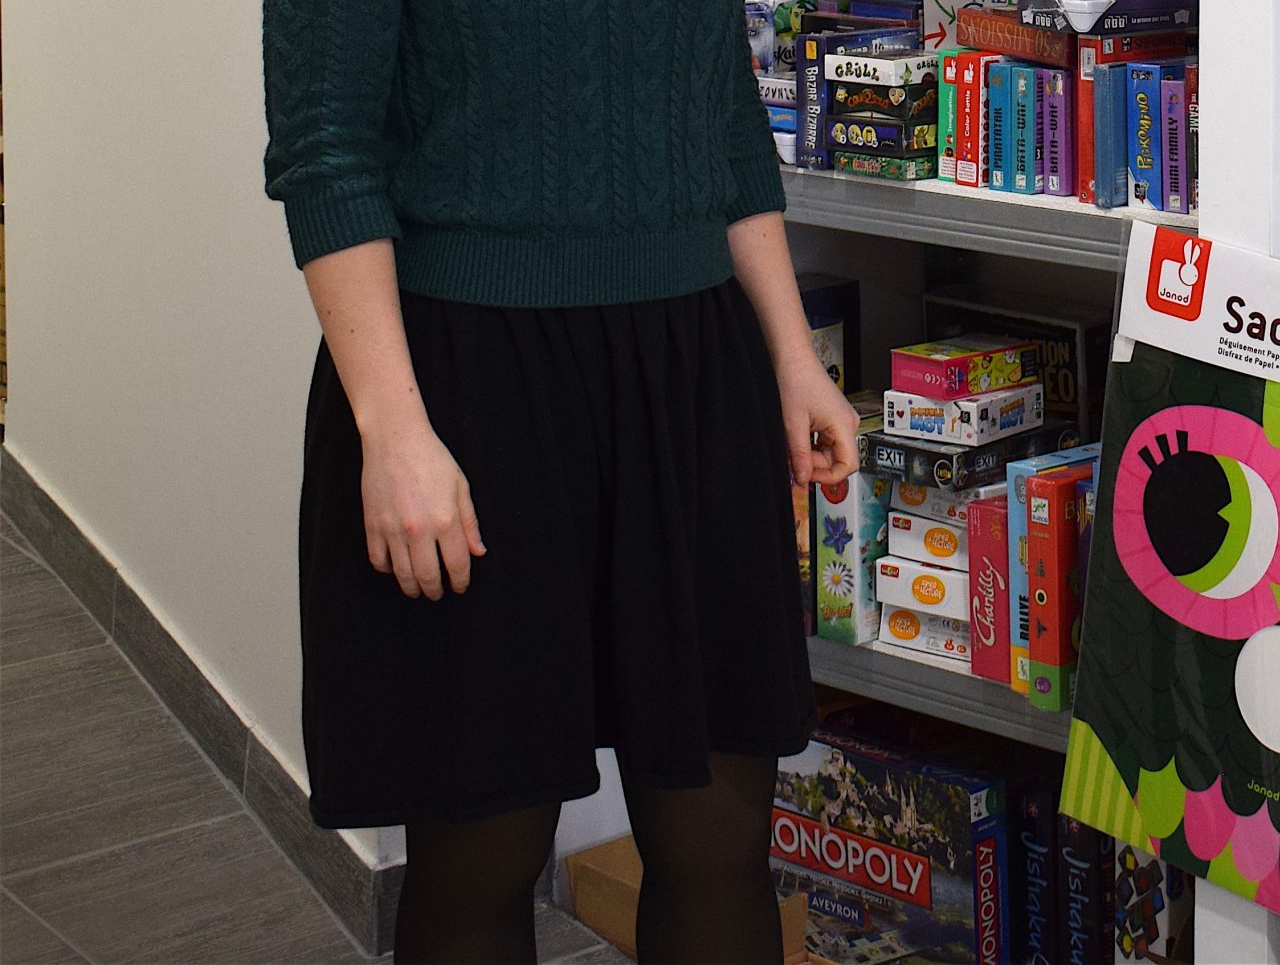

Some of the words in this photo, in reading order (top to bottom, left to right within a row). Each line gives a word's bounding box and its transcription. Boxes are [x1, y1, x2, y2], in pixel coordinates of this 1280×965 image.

[805, 66, 819, 102] BAZAR
[806, 105, 821, 150] BIZARRE
[1188, 104, 1199, 134] GAME
[993, 107, 1002, 168] PIRATATAK
[1049, 101, 1058, 174] BATA-WAF
[1167, 117, 1178, 159] FAMILY
[1168, 161, 1180, 193] MINI
[1159, 287, 1191, 306] Janod
[1217, 347, 1243, 361] Disfraz
[1244, 354, 1254, 363] de
[1254, 356, 1275, 370] Papel
[1219, 336, 1266, 358] Déguisement
[910, 415, 945, 435] MOT
[877, 447, 904, 467] EXIT
[976, 454, 997, 467] EXIT
[920, 586, 943, 599] LECTURE
[973, 556, 1006, 647] Chantilly
[1247, 779, 1280, 801] Janod
[1021, 831, 1048, 949] Jishaku
[811, 895, 860, 921] AVEYRON
[1062, 846, 1090, 965] Jishaku
